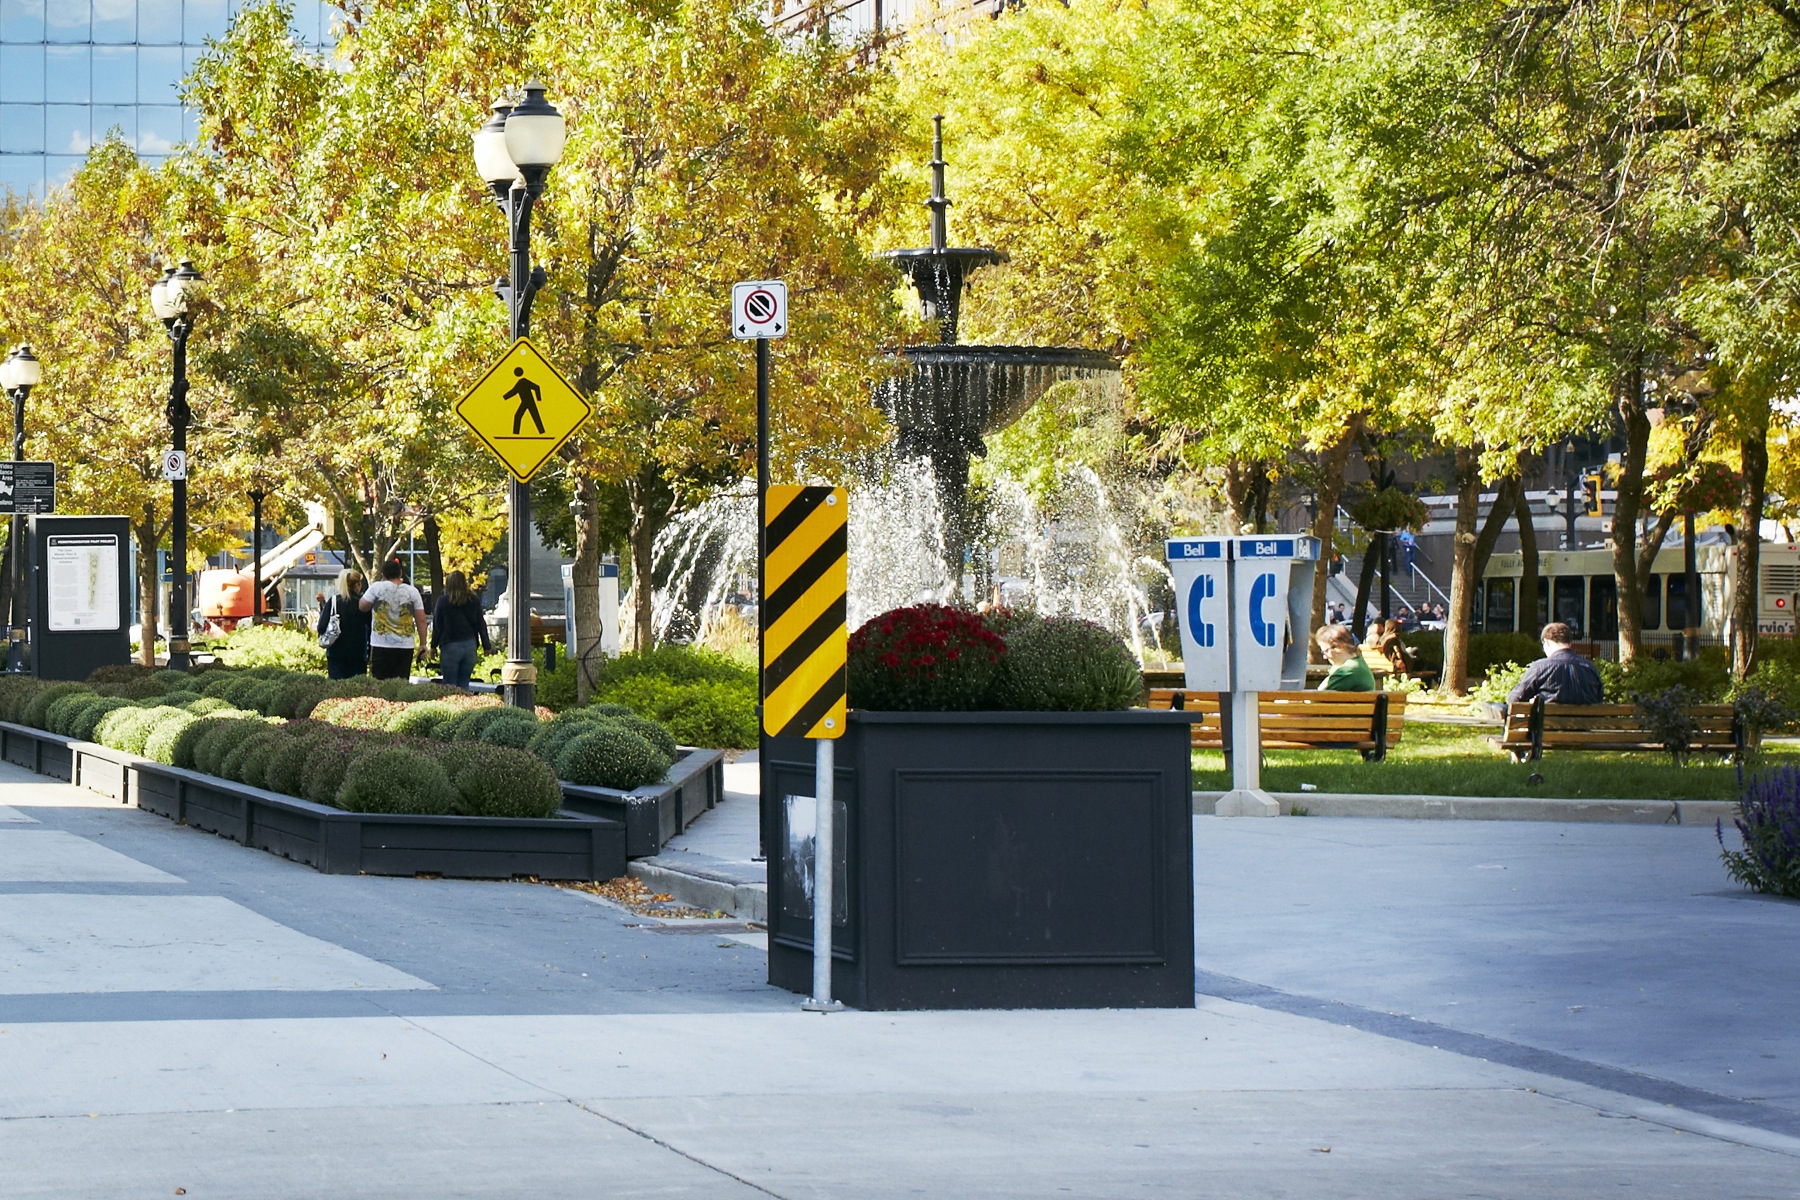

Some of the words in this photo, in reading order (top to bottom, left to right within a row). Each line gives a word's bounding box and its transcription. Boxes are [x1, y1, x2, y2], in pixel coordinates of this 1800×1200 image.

[1183, 543, 1205, 557] Bell
[1255, 541, 1277, 555] Bell
[1758, 621, 1795, 633] rvin's
